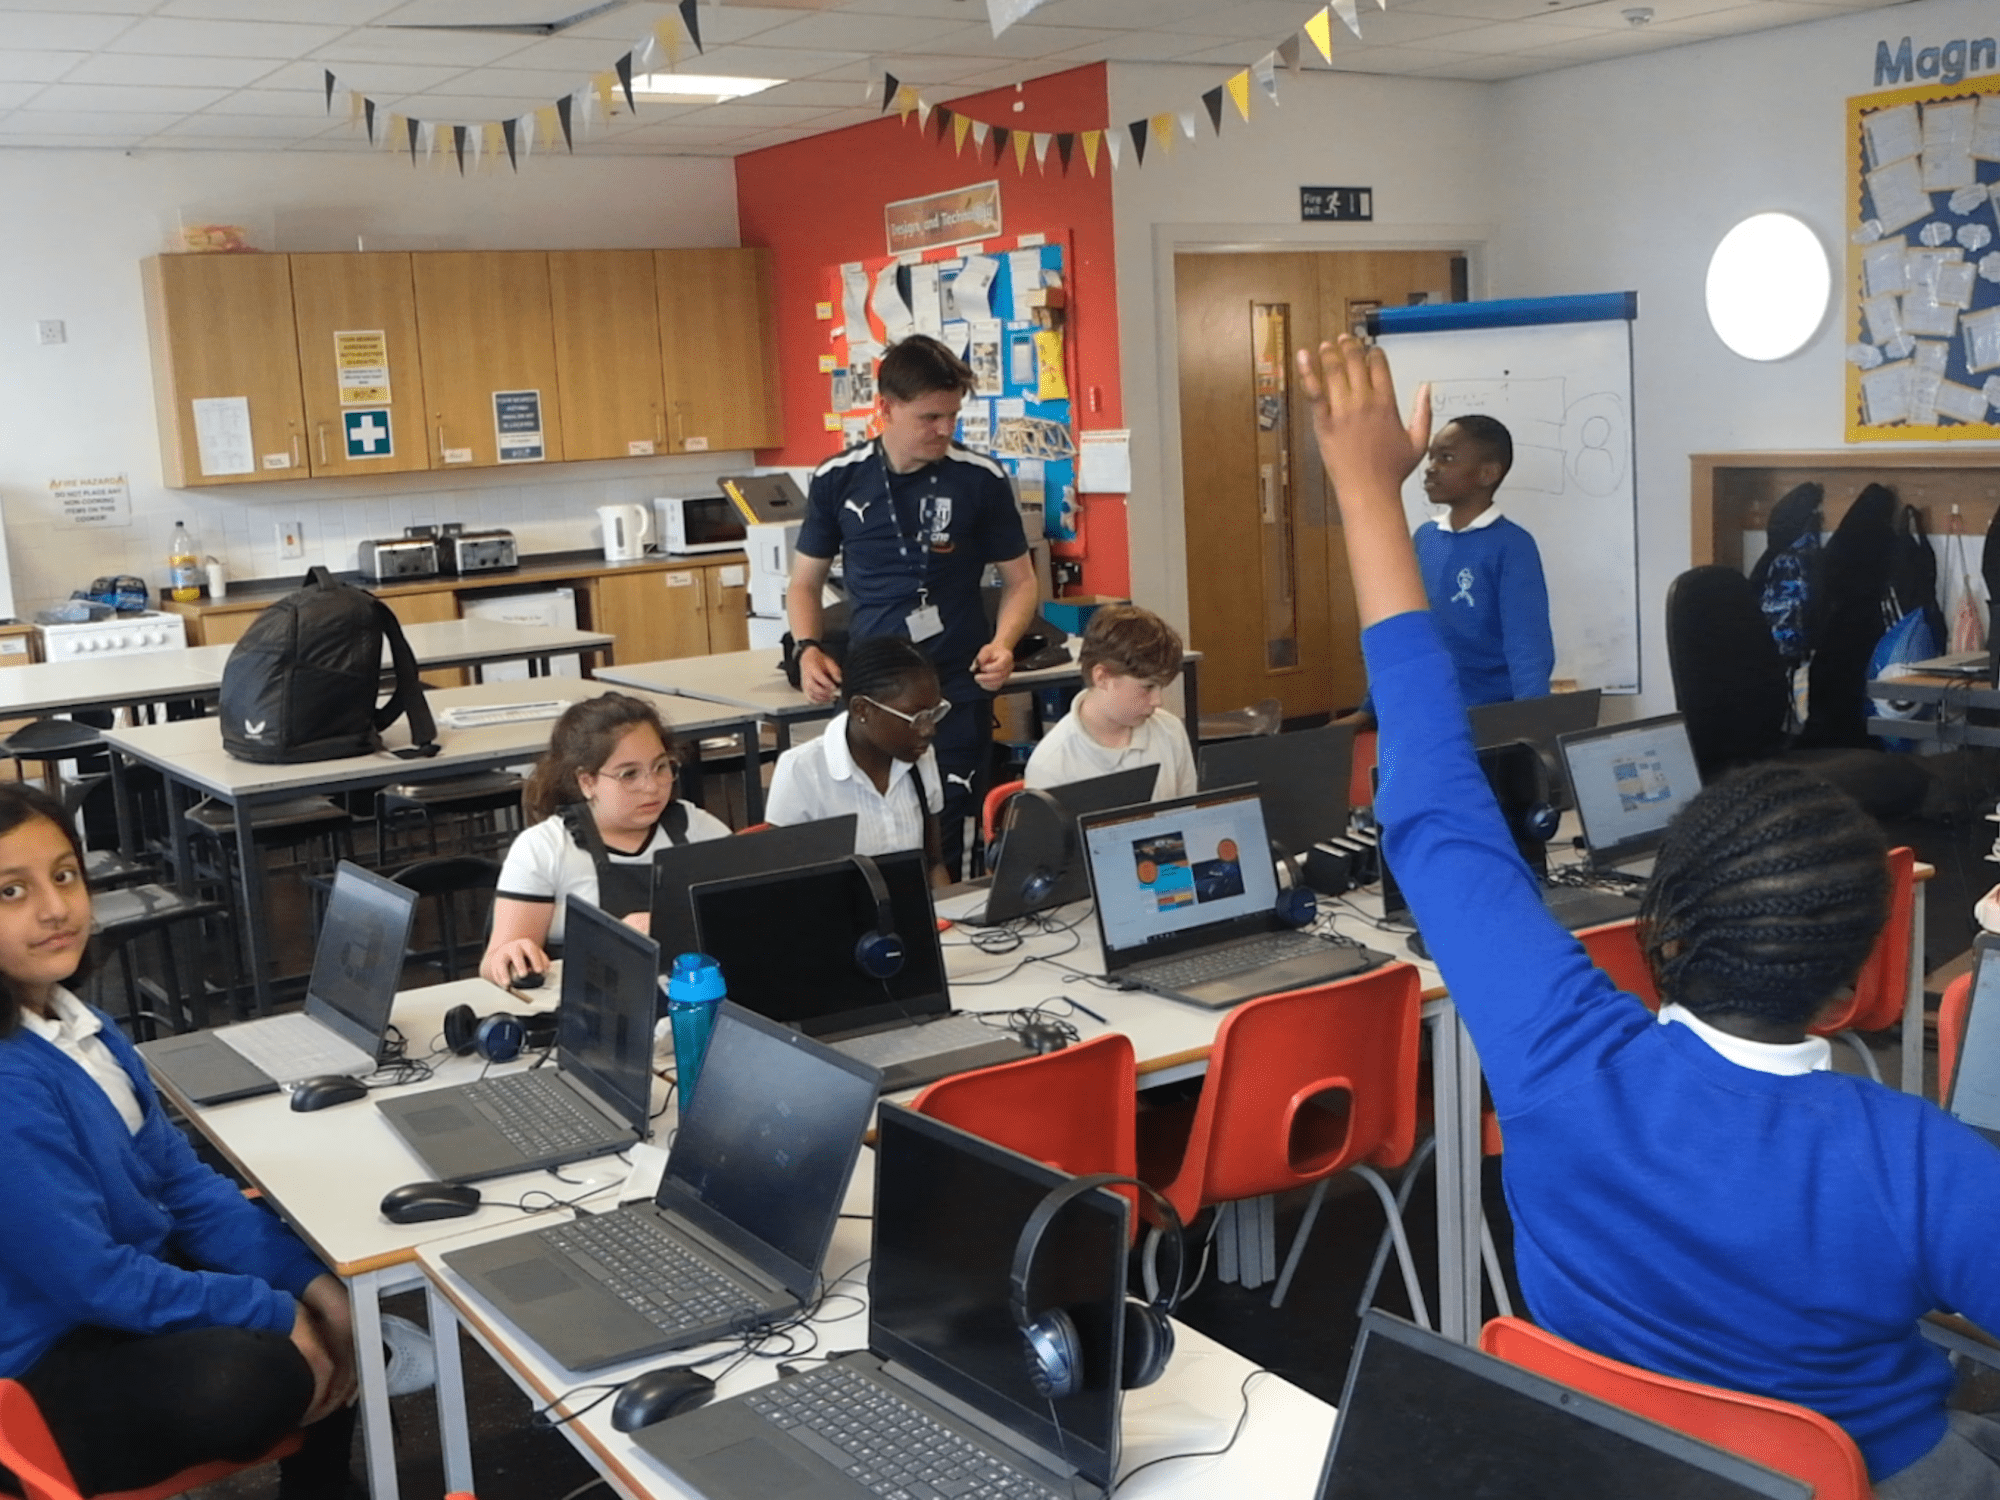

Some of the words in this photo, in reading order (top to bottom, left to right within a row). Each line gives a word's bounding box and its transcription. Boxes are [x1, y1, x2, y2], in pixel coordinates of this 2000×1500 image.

[1873, 36, 1997, 86] Magn
[1303, 193, 1321, 204] Fire
[1304, 205, 1320, 215] exit
